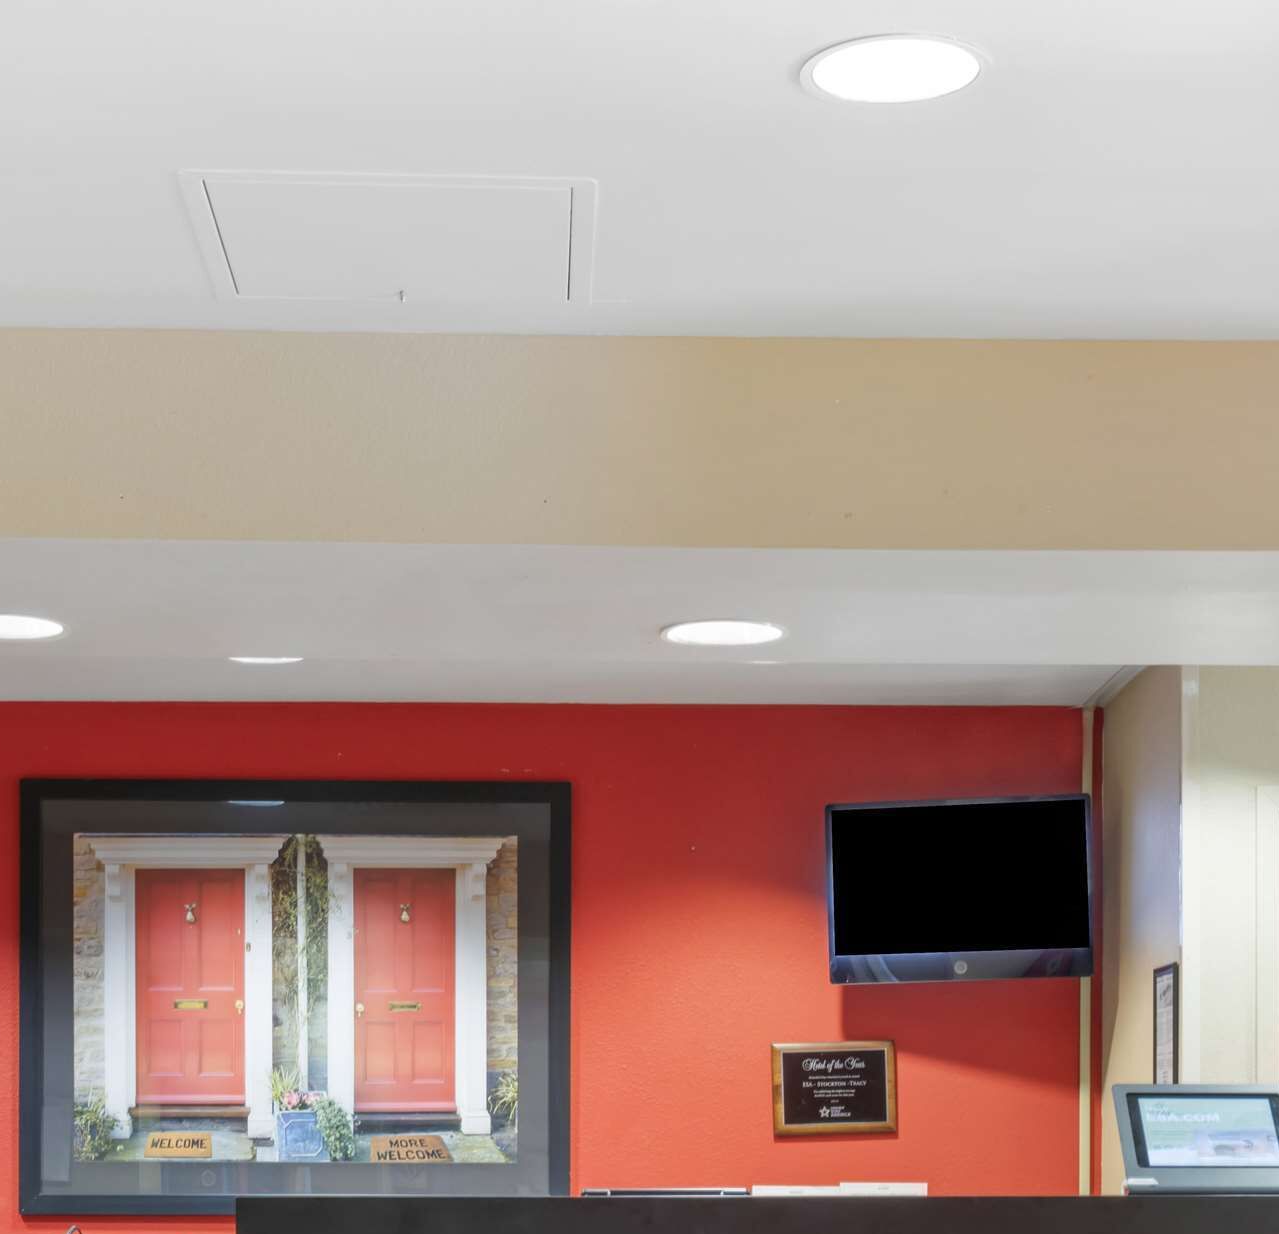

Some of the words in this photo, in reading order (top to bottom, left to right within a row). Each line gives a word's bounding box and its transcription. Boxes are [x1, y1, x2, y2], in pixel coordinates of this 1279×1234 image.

[802, 1057, 826, 1071] Hotel
[826, 1059, 835, 1073] of
[834, 1059, 844, 1070] the
[844, 1056, 866, 1070] Year
[150, 1138, 207, 1149] WELCOME
[388, 1138, 428, 1148] MORE
[376, 1149, 446, 1161] WELCOME
